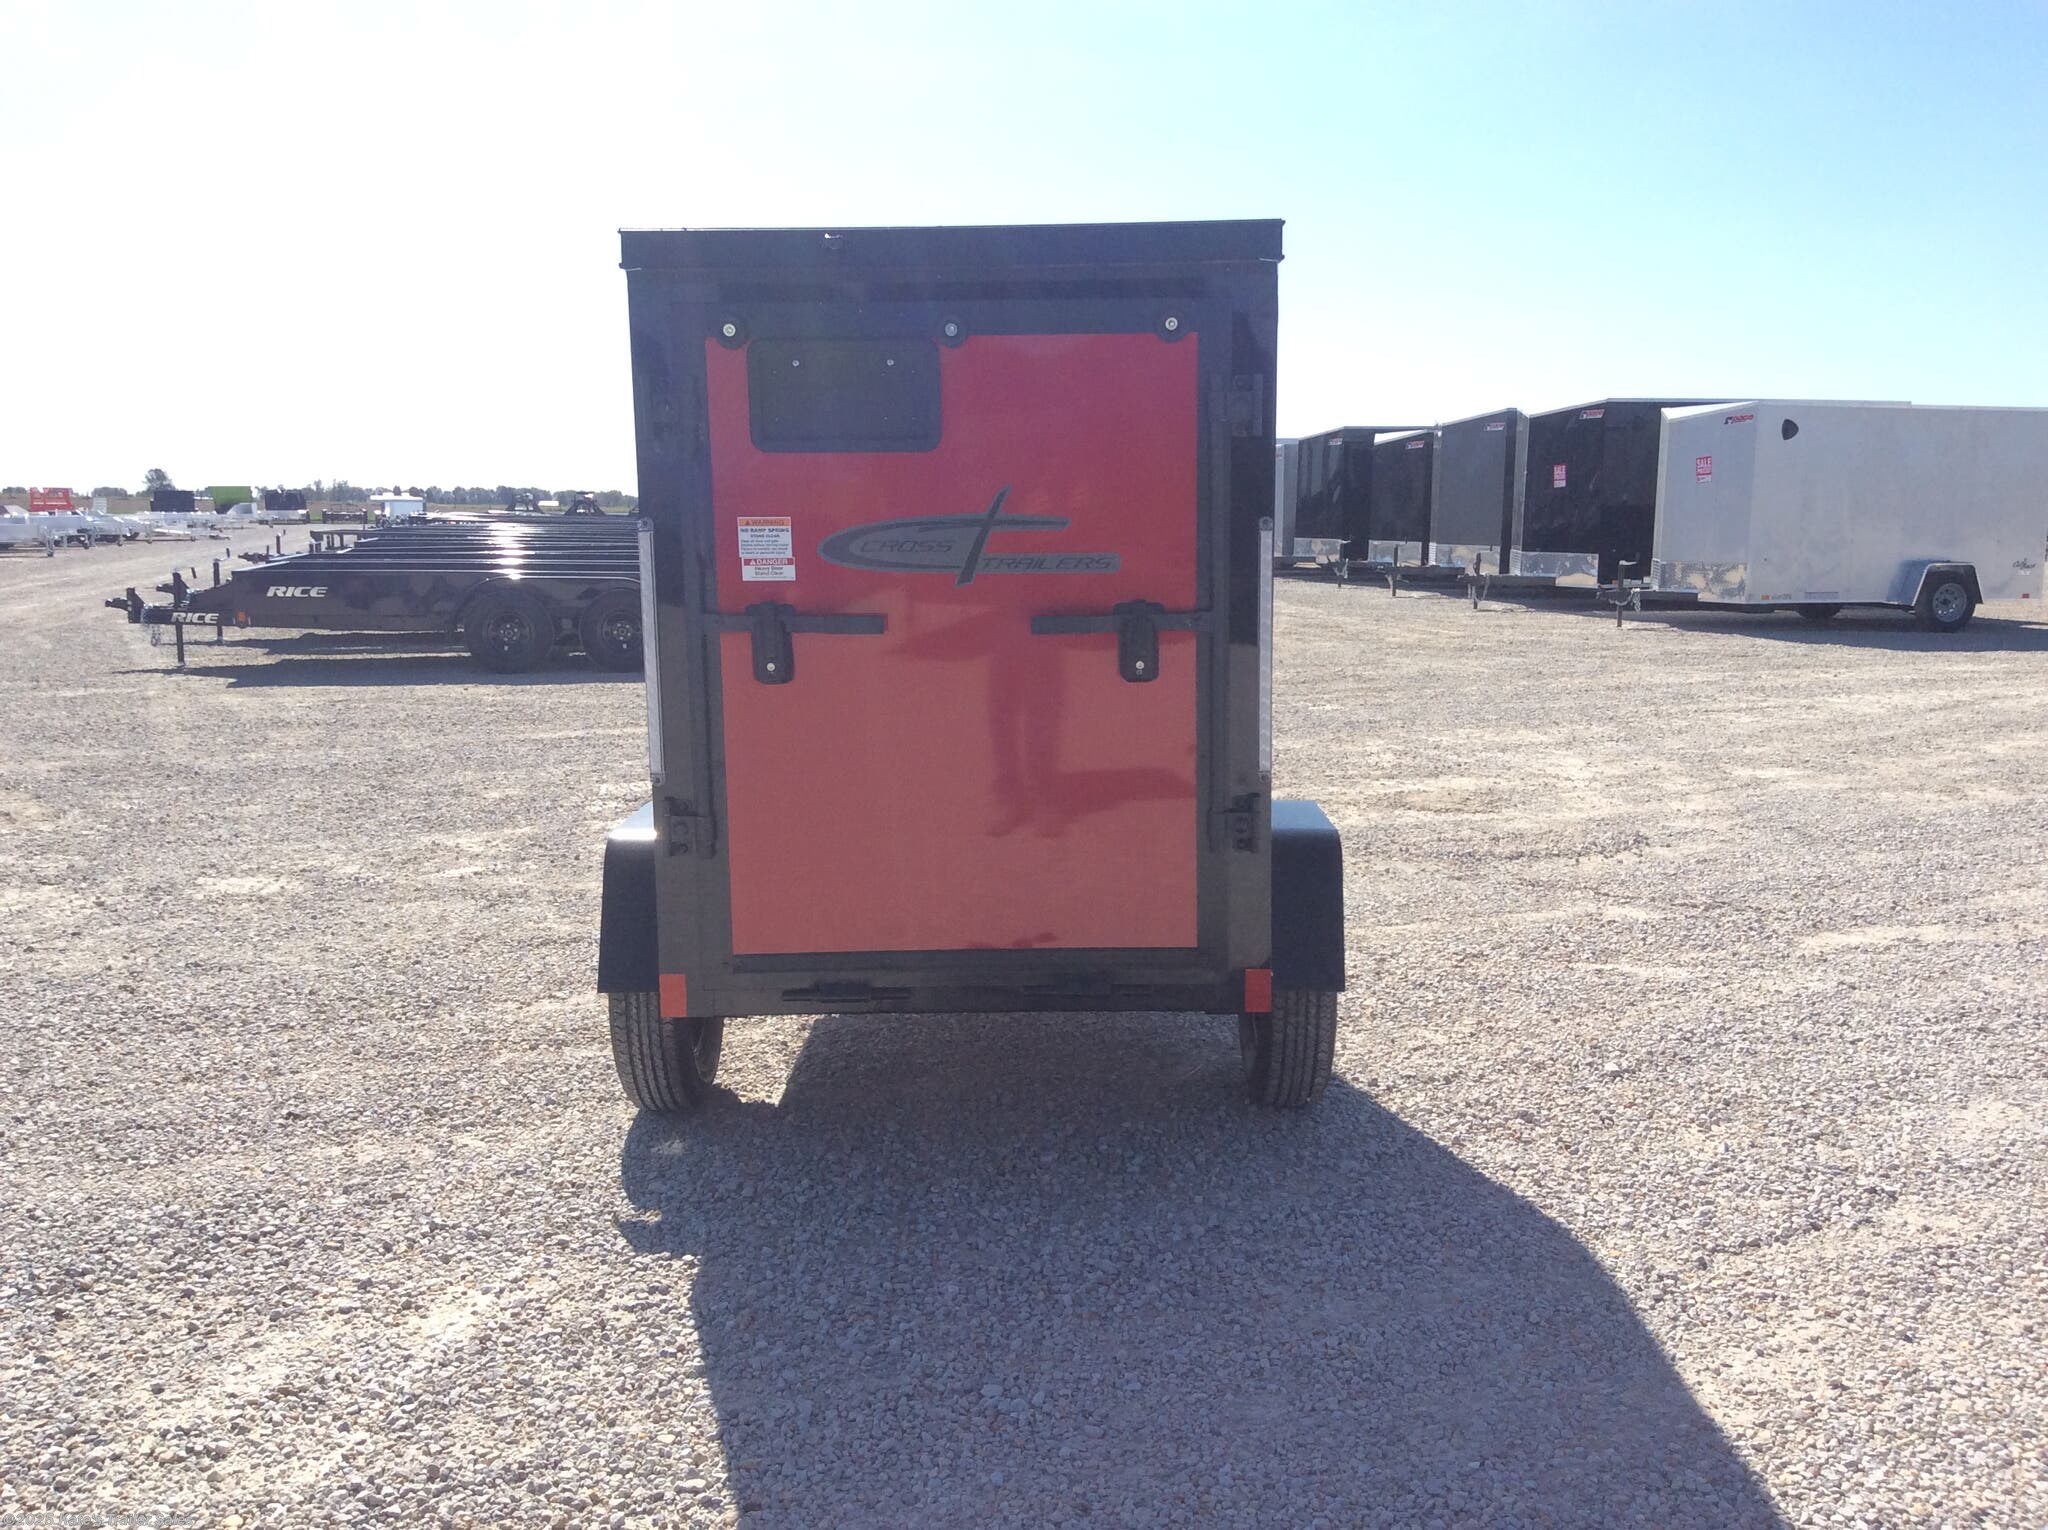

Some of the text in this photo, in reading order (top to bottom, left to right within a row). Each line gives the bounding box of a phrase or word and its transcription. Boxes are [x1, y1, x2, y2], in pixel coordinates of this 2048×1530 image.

[859, 540, 956, 552] CROSS
[756, 558, 788, 566] DANGER
[982, 556, 1112, 570] TRAILERS
[266, 586, 328, 597] RICE
[170, 612, 220, 624] RICE
